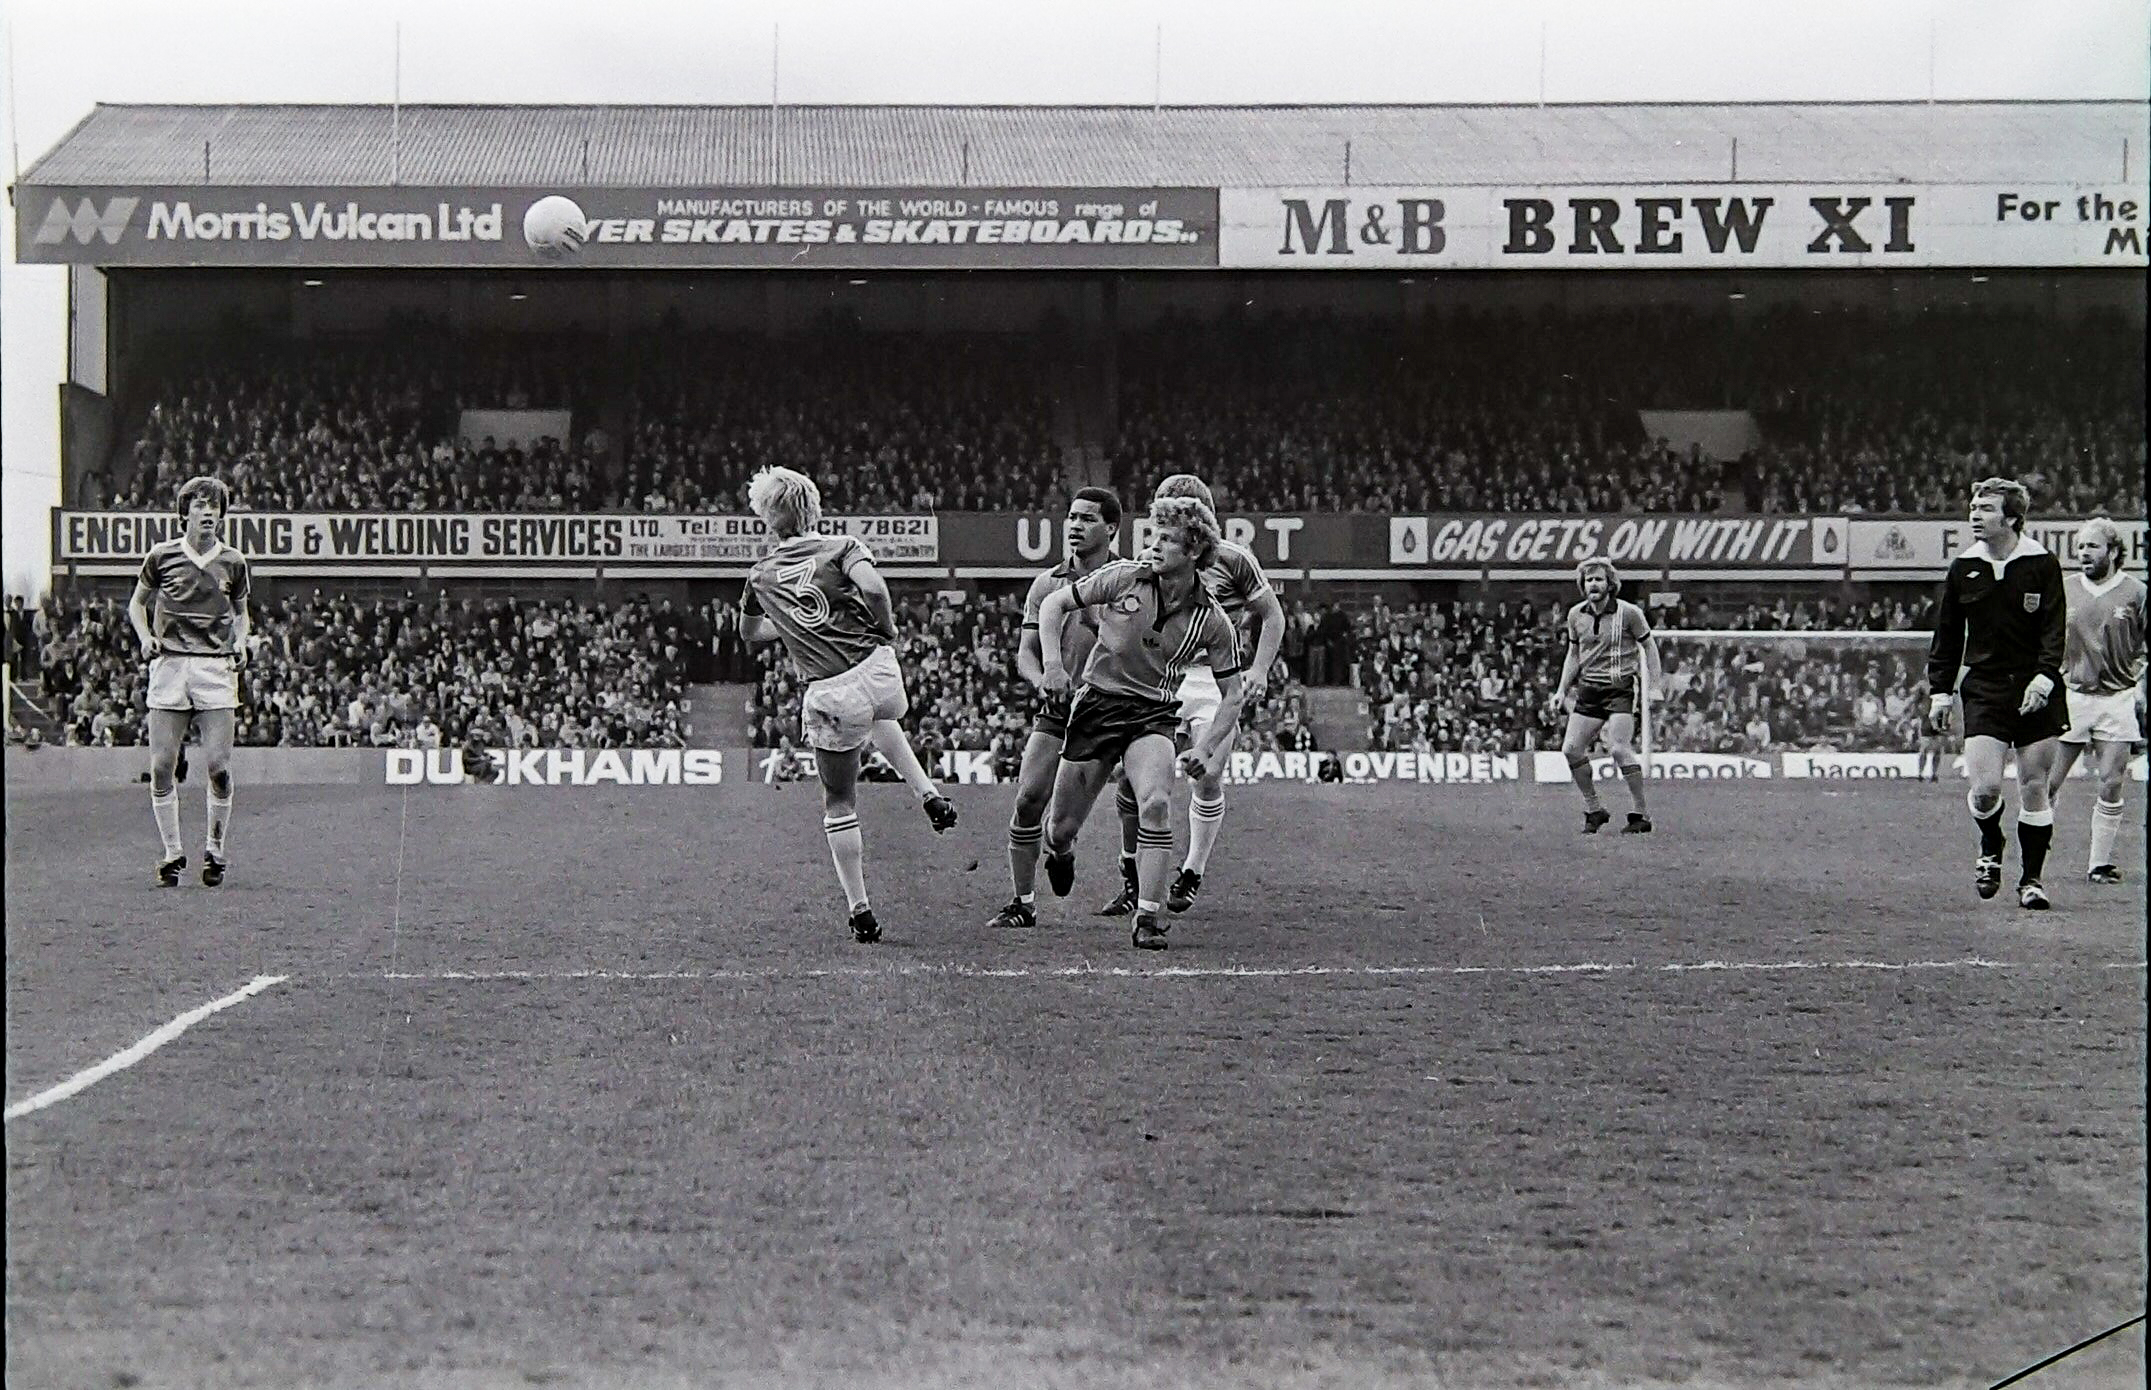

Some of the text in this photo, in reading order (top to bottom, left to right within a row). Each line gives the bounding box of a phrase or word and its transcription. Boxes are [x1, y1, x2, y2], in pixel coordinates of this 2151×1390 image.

[147, 202, 502, 241] Morris Vulcan Ltd
[657, 199, 813, 216] MANUFACTURERS
[824, 200, 849, 216] OF
[857, 200, 890, 217] THE
[1075, 203, 1124, 220] range
[1138, 201, 1158, 216] of
[1998, 193, 2138, 221] For the
[661, 219, 834, 244] SKATES
[836, 225, 857, 244] &
[1278, 197, 1914, 255] M&B BREW XI
[303, 524, 322, 553] &
[330, 518, 470, 556] WELDING
[482, 519, 622, 556] SERVICES
[630, 519, 664, 538] LTD.
[860, 520, 929, 535] 78621
[1432, 519, 1807, 561] GAS GETS ON WITH IT
[776, 558, 830, 628] 3
[1343, 752, 1519, 780] OVENDEN
